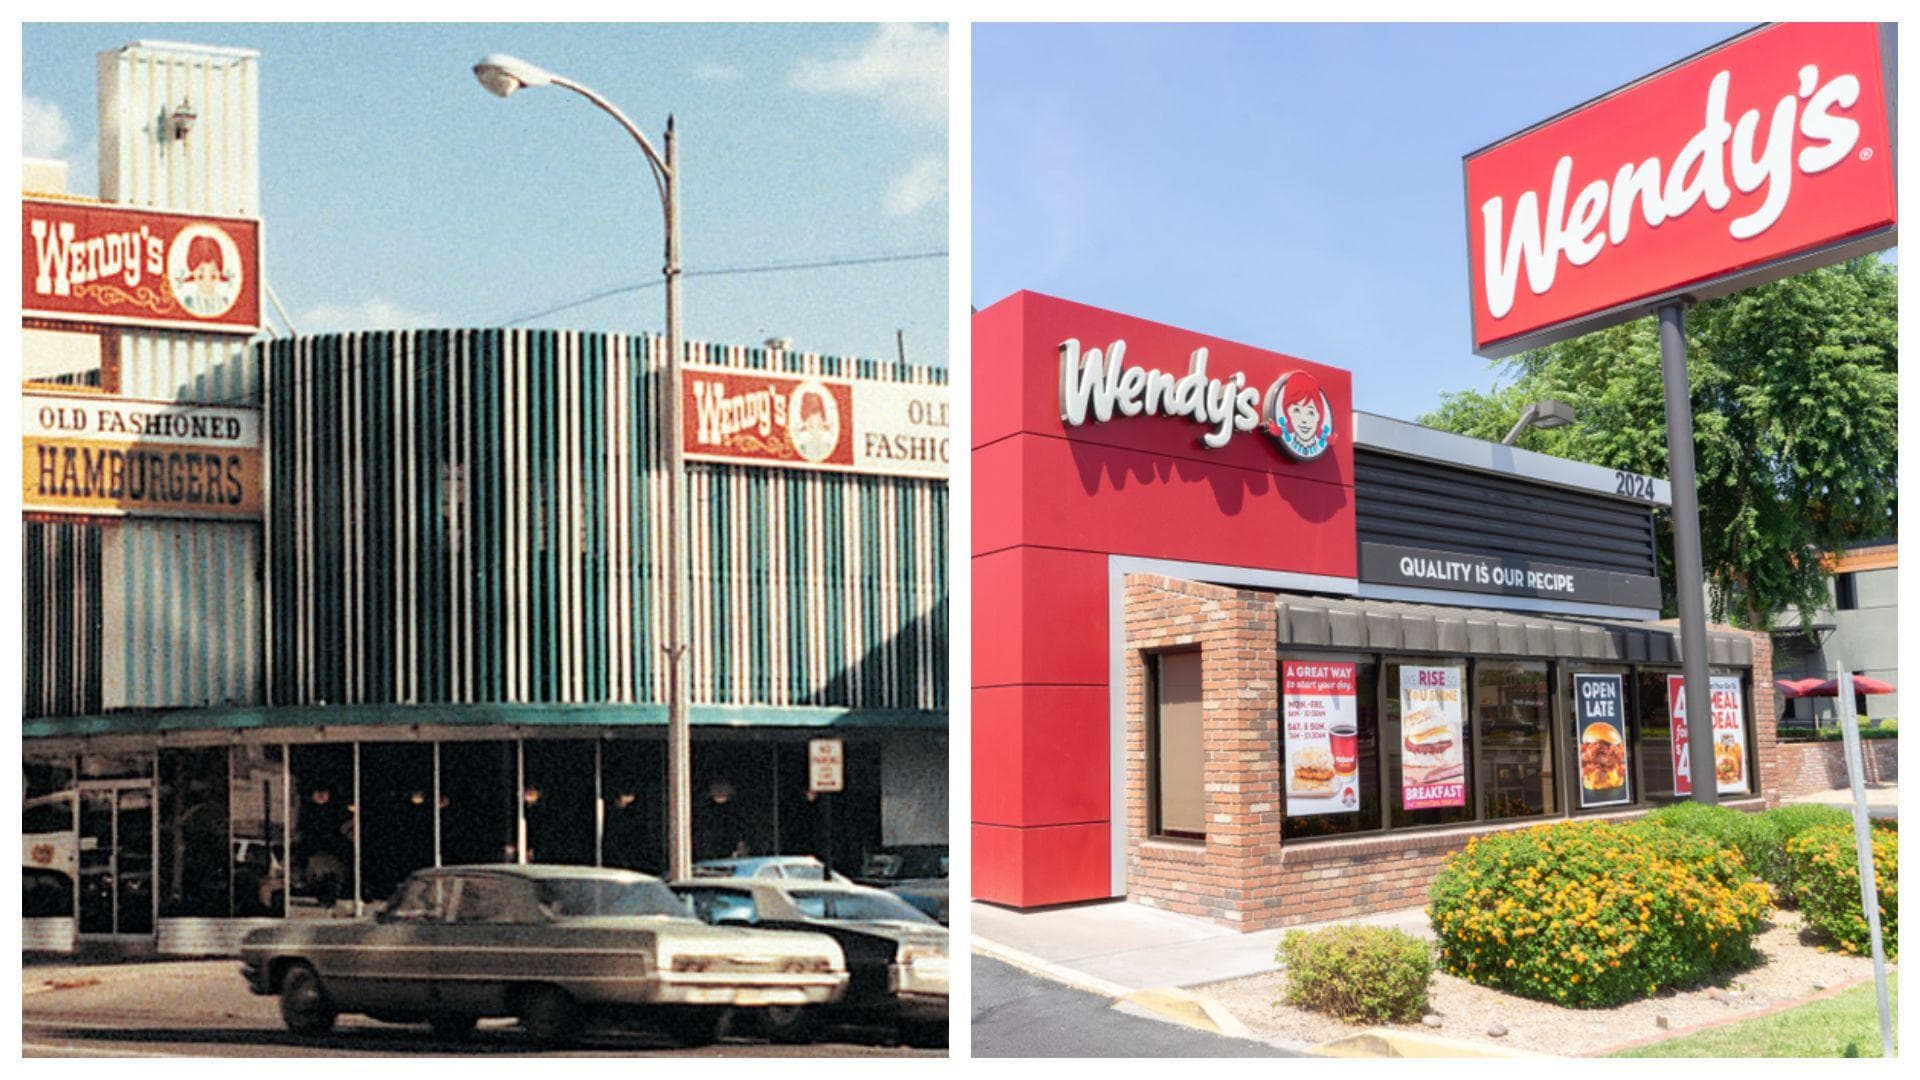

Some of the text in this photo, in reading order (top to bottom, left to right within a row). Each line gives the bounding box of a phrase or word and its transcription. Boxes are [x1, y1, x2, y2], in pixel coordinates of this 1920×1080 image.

[1481, 64, 1860, 318] Wendy's
[1058, 338, 1260, 448] Wendy's
[39, 406, 241, 440] OLD FASHIONED
[37, 445, 242, 504] HAMBURGERS
[1616, 471, 1655, 499] 2024
[1400, 556, 1575, 593] QUALITY IS OUR RECIPE
[1286, 664, 1352, 679] A GREAT WAY
[1419, 670, 1445, 686] RISE
[1286, 680, 1295, 688] to
[1317, 682, 1335, 691] your
[1582, 681, 1616, 698] OPEN
[1586, 701, 1615, 718] LATE
[1406, 785, 1463, 801] BREAKFAST
